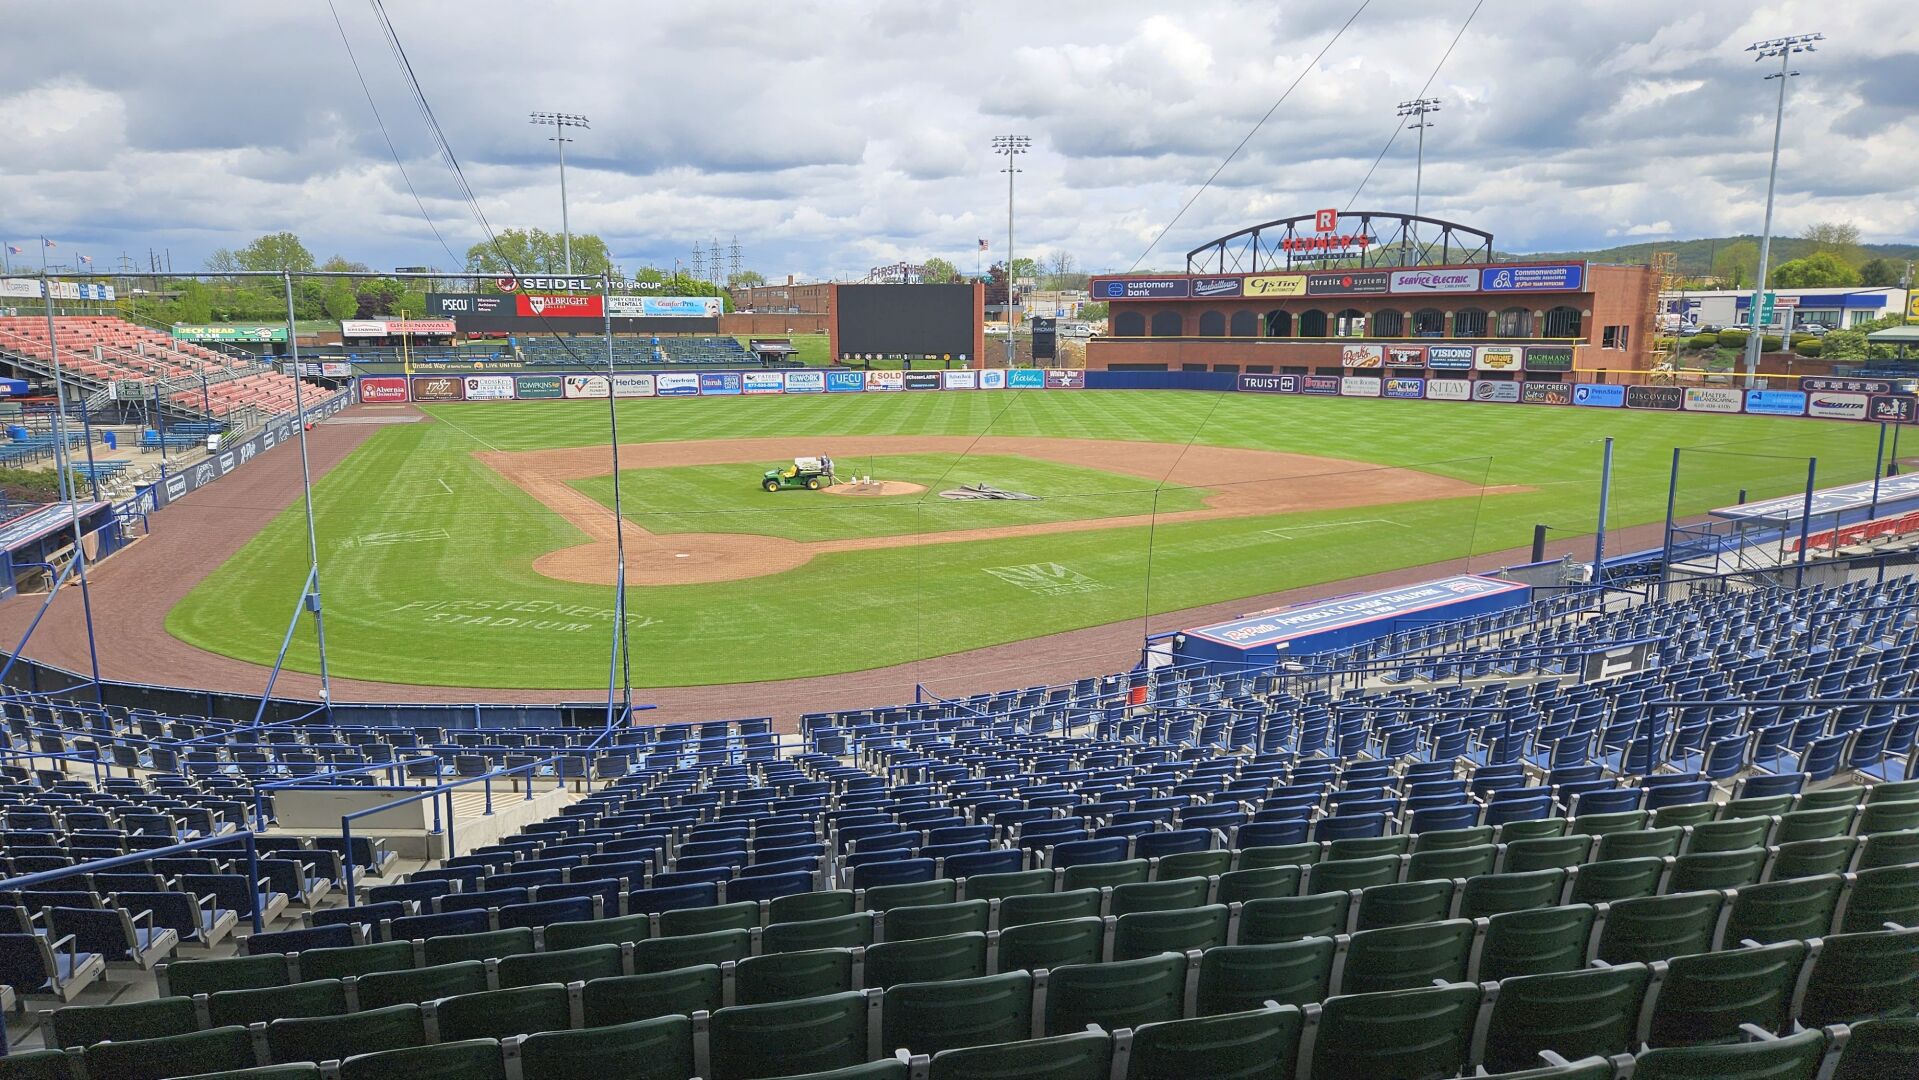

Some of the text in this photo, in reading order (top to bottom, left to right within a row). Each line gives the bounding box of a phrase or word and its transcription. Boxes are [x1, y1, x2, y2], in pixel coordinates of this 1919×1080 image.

[1320, 212, 1331, 228] R
[1514, 268, 1567, 276] Commonwealth
[523, 277, 661, 290] SEIDEL ATO GROUP
[1127, 281, 1174, 289] customers
[1310, 277, 1386, 286] stratix systems
[1398, 274, 1469, 286] SERVICE ELECTRIC
[1127, 288, 1150, 298] bank
[442, 299, 468, 311] PSECU
[544, 296, 589, 305] ALBRIGHT
[1430, 349, 1471, 358] VISIONS
[1484, 353, 1512, 364] UNIQUE
[877, 372, 901, 380] SOLD
[426, 378, 451, 393] 1787
[1244, 377, 1279, 388] TRUIST
[1397, 381, 1420, 389] NEWS
[1429, 381, 1466, 393] KITAY
[1629, 392, 1680, 402] DISCOVERY
[169, 482, 185, 493] PENSKE
[1276, 606, 1342, 627] AMERICA'S
[1338, 597, 1385, 615] CLASSIC
[1384, 587, 1444, 604] BALLPARK
[388, 599, 664, 629] FIRSTENERGY
[424, 612, 593, 633] STADIUM
[91, 967, 100, 977] 20
